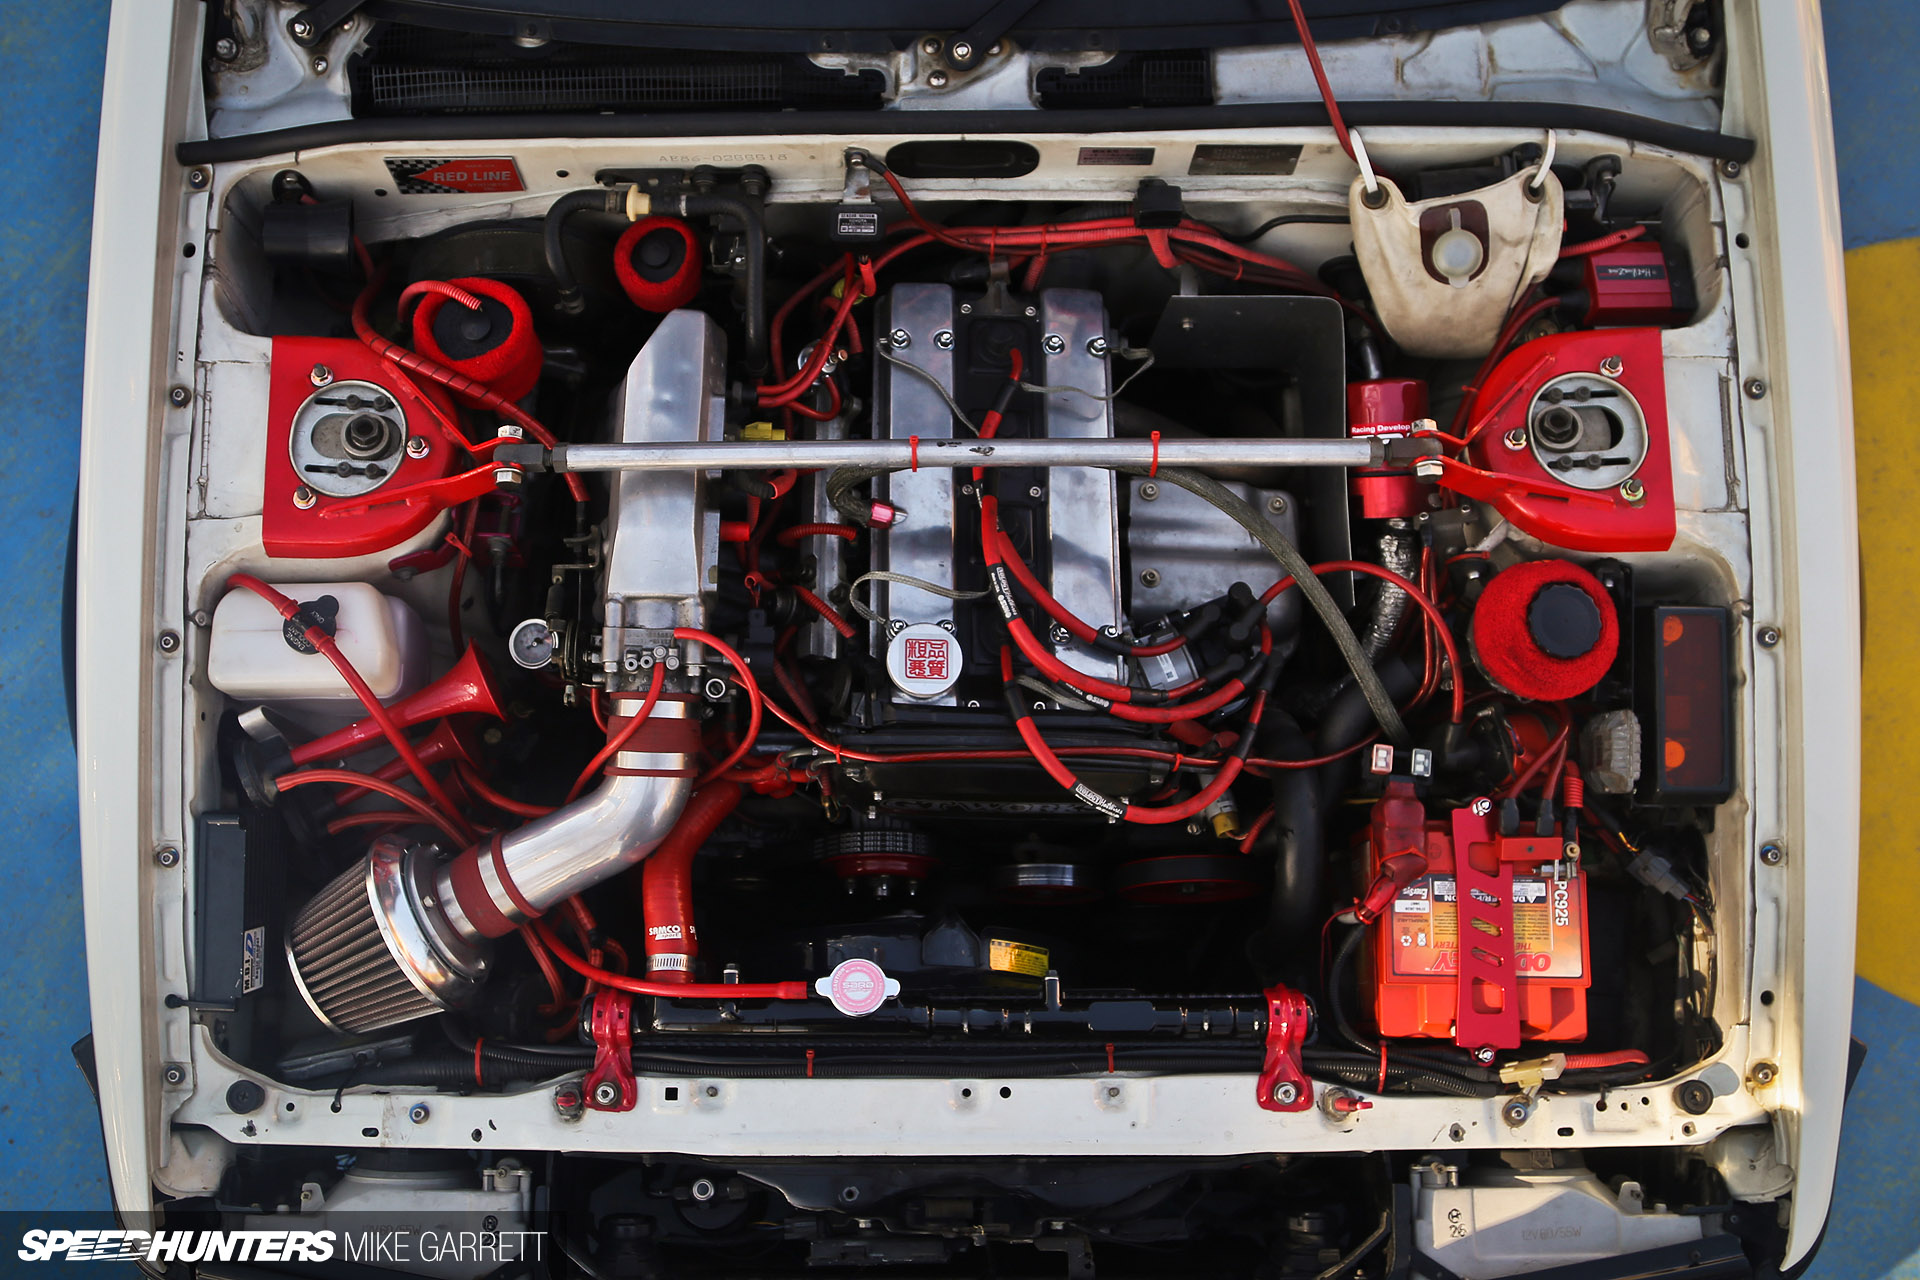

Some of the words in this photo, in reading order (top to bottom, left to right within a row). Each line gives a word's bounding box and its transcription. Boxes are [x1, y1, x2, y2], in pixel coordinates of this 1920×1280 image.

[433, 171, 468, 181] RED
[473, 170, 512, 181] LINE
[1351, 426, 1376, 434] Racing
[311, 611, 324, 623] ONLY
[285, 632, 305, 650] ENGINE
[1554, 880, 1569, 927] PC925
[648, 925, 681, 936] SAMCO
[1516, 942, 1531, 950] THE
[833, 967, 845, 992] CAUTION
